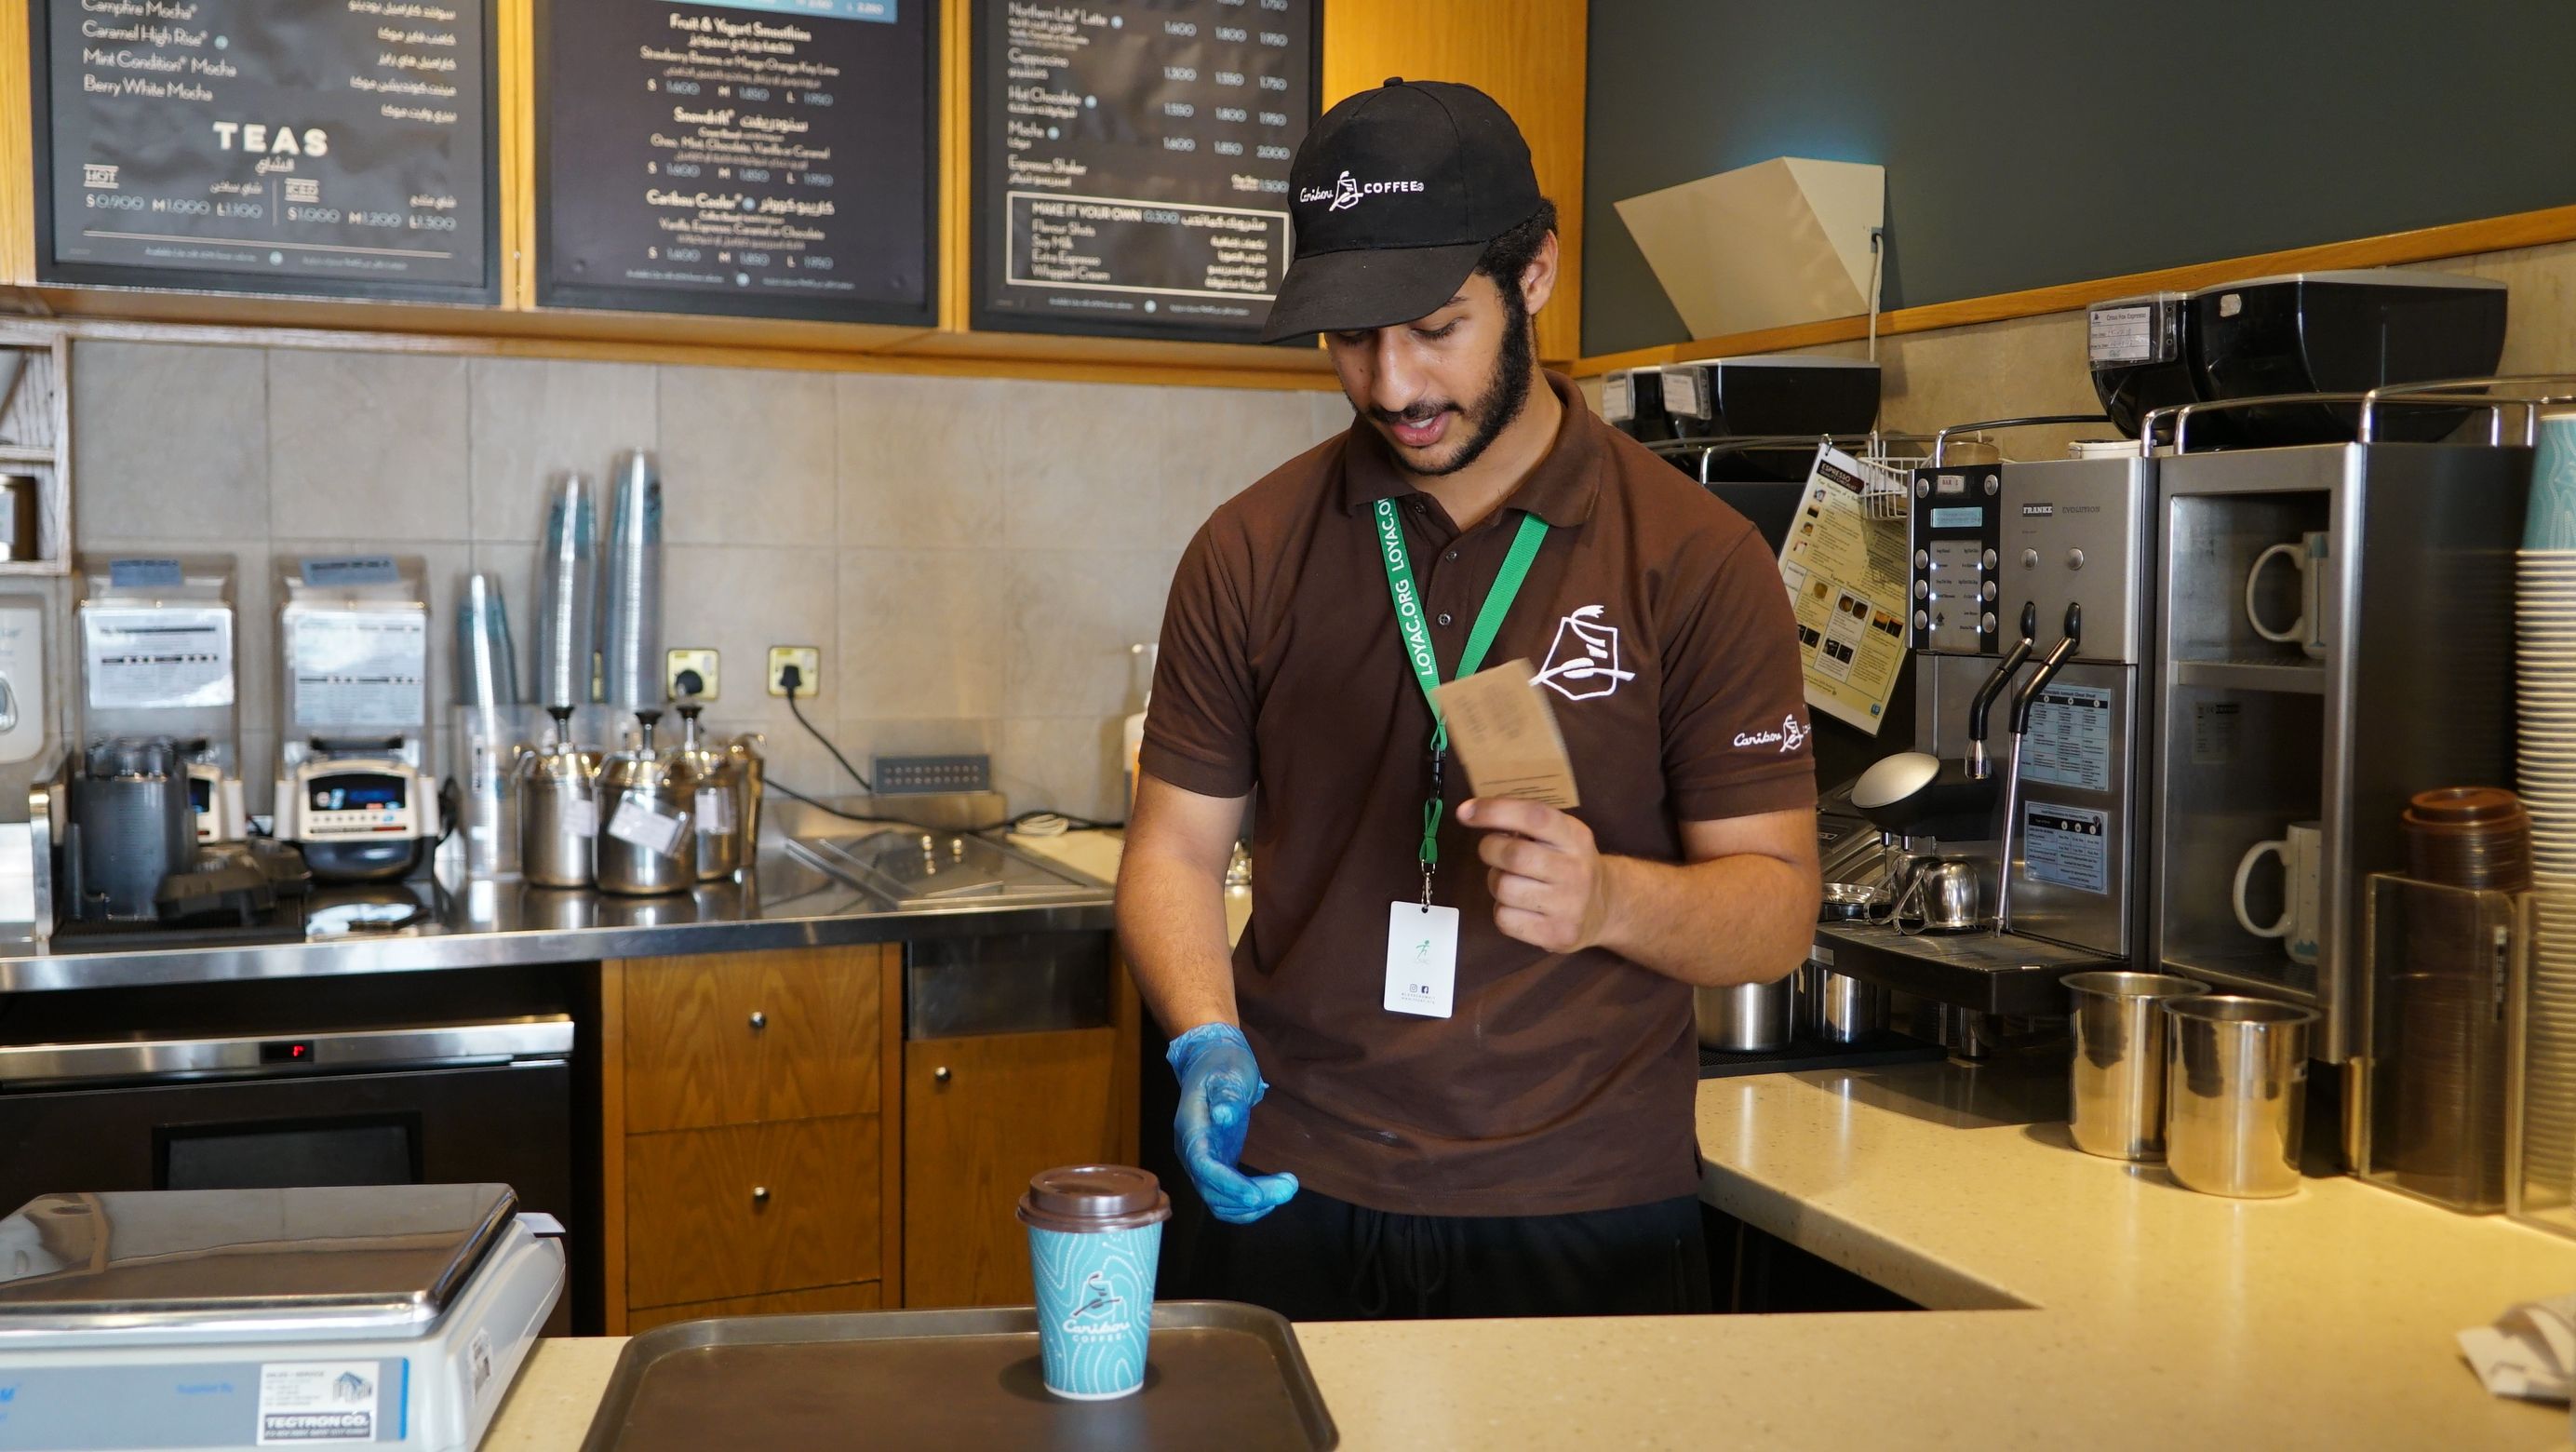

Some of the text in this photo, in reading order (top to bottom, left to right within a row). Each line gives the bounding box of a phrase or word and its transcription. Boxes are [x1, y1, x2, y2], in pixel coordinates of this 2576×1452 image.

[669, 12, 812, 42] Fruit & Yogurt Smoothies
[1080, 8, 1108, 27] Latte
[82, 20, 139, 41] Caramel
[141, 24, 172, 47] High
[83, 47, 237, 77] Mint Condition Mocha
[1008, 47, 1069, 68] Cappuccino
[84, 74, 213, 101] Berry White Mocha
[648, 78, 657, 91] S
[718, 85, 731, 98] M
[786, 91, 796, 103] L
[1008, 85, 1081, 106] Hot Chocolate
[212, 121, 328, 157] TEAS
[1008, 120, 1045, 139] Mocha
[1256, 144, 1290, 160] 2.000
[647, 160, 657, 174] S
[718, 168, 731, 180] M
[786, 171, 796, 184] L
[1008, 154, 1088, 175] Espresso Shaker
[85, 168, 116, 182] HOT
[646, 188, 736, 210] Caribou Cooler
[1300, 181, 1417, 203] Caribou COFFEE
[1032, 202, 1066, 217] MAKE
[1066, 204, 1077, 218] IT
[1077, 205, 1111, 220] YOUR
[1111, 207, 1142, 222] OWN
[1032, 233, 1074, 250] Soy Milk
[649, 246, 658, 260] S
[718, 251, 731, 263] M
[786, 255, 796, 268] L
[1032, 248, 1101, 266] Extra Espresso
[1031, 263, 1110, 281] Whipped Cream
[1821, 463, 1851, 482] ESPRESSO
[2023, 505, 2100, 514] FRANKE EVOLUTION
[1396, 579, 1433, 676] LOYAC.ORG
[1734, 731, 1782, 746] Caribou
[1063, 1318, 1130, 1335] Caribou
[1072, 1334, 1124, 1343] COFFEE
[266, 1414, 369, 1430] TECTRON CO.
